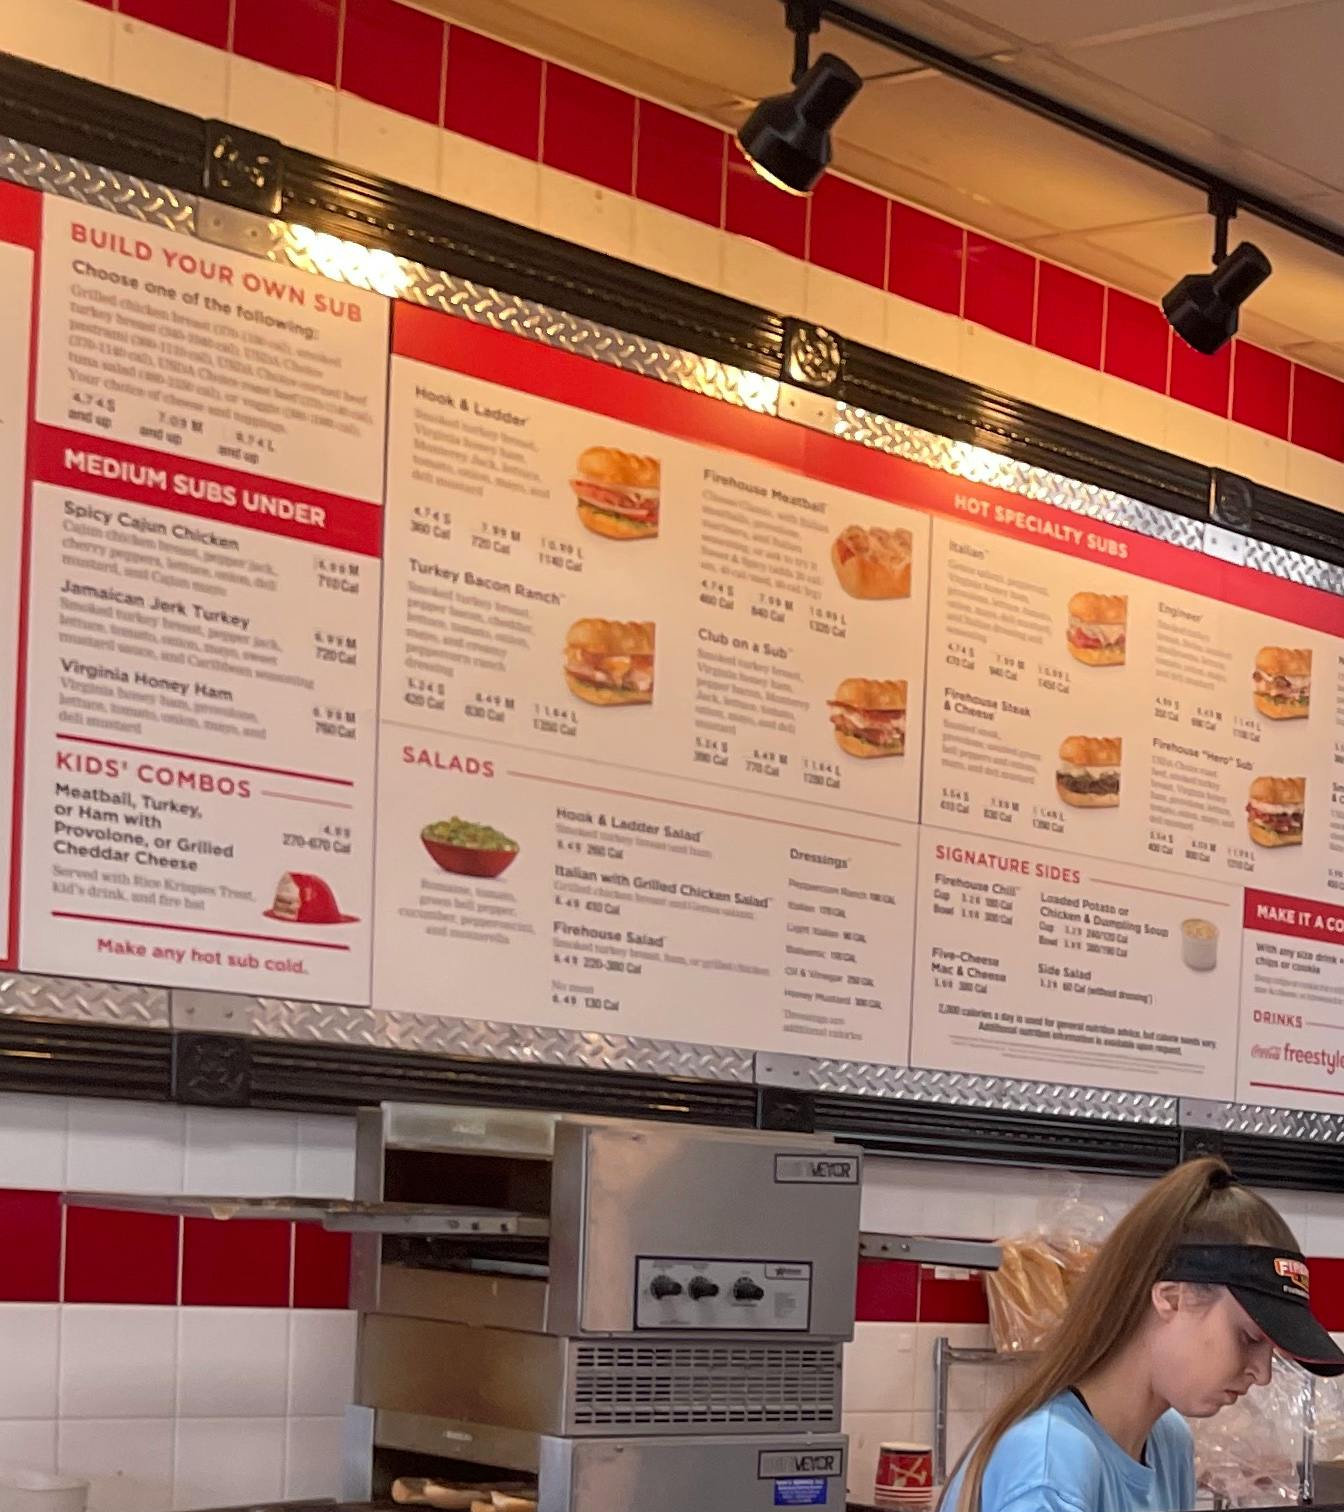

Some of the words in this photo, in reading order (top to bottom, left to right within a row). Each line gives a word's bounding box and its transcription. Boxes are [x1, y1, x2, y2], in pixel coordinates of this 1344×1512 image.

[71, 222, 152, 262] BUILD
[161, 247, 234, 287] YOUR
[243, 271, 305, 306] OWN
[314, 293, 363, 323] SUB
[73, 260, 138, 289] Choose
[145, 280, 176, 301] one
[184, 289, 202, 306] of
[205, 293, 232, 315] the
[237, 302, 318, 338] following:
[64, 449, 167, 490] MEDIUM
[173, 474, 236, 507] SUBS
[243, 489, 327, 528] UNDER
[64, 500, 112, 526] Spicy
[117, 511, 167, 538] Cajun
[172, 524, 240, 551] Chicken
[954, 494, 991, 518] HOT
[995, 505, 1083, 545] SPECIALTY
[1087, 531, 1129, 559] SUBS
[409, 557, 460, 585] Turkey
[464, 571, 512, 594] Bacon
[60, 580, 144, 607] Jamaican
[150, 595, 187, 617] Jerk
[192, 605, 250, 631] Turkey
[59, 657, 130, 685] Virginia
[134, 671, 190, 696] Honey
[194, 682, 234, 702] Ham
[56, 751, 129, 779] KIDS'
[137, 765, 252, 799] COMBOS
[403, 746, 495, 778] SALADS
[54, 804, 73, 818] or
[79, 806, 119, 825] Ham
[124, 813, 163, 830] with
[55, 782, 138, 810] Meatball,
[141, 795, 203, 819] Turkey,
[54, 820, 150, 849] Provolone,
[154, 836, 173, 850] or
[177, 839, 235, 859] Grilled
[54, 840, 130, 865] Cheddar
[135, 850, 199, 873] Cheese
[936, 844, 1030, 875] SIGNATURE
[1035, 863, 1082, 884] SIDES
[1257, 904, 1296, 924] MAKE
[1298, 911, 1311, 927] IT
[1314, 914, 1326, 929] A
[97, 938, 146, 960] Make
[152, 947, 185, 965] any
[190, 948, 222, 966] hot
[228, 953, 260, 970] sub
[265, 956, 310, 976] cold.
[1253, 1009, 1303, 1028] DRINKS
